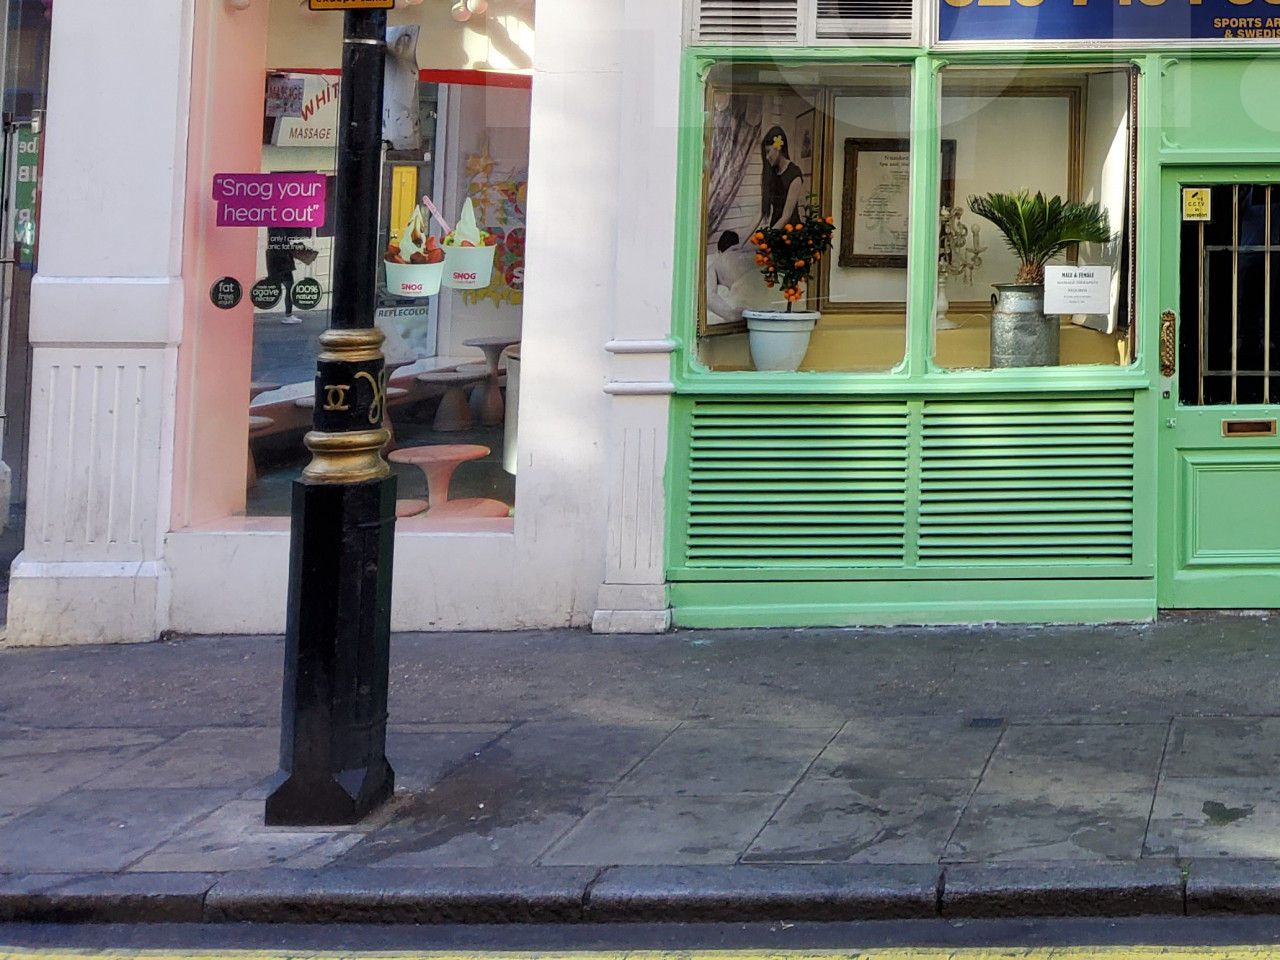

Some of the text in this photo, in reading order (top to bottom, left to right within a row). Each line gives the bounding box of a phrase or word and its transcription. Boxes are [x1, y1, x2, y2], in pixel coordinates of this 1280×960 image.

[1213, 18, 1262, 28] SPORTS
[1224, 29, 1233, 38] &
[289, 127, 332, 140] MASSAGE
[277, 182, 322, 200] your
[223, 203, 277, 221] heart
[453, 272, 477, 280] SNOG
[219, 282, 234, 292] fat
[296, 285, 319, 293] 100%
[401, 283, 423, 291] SNOG
[252, 289, 279, 298] agave
